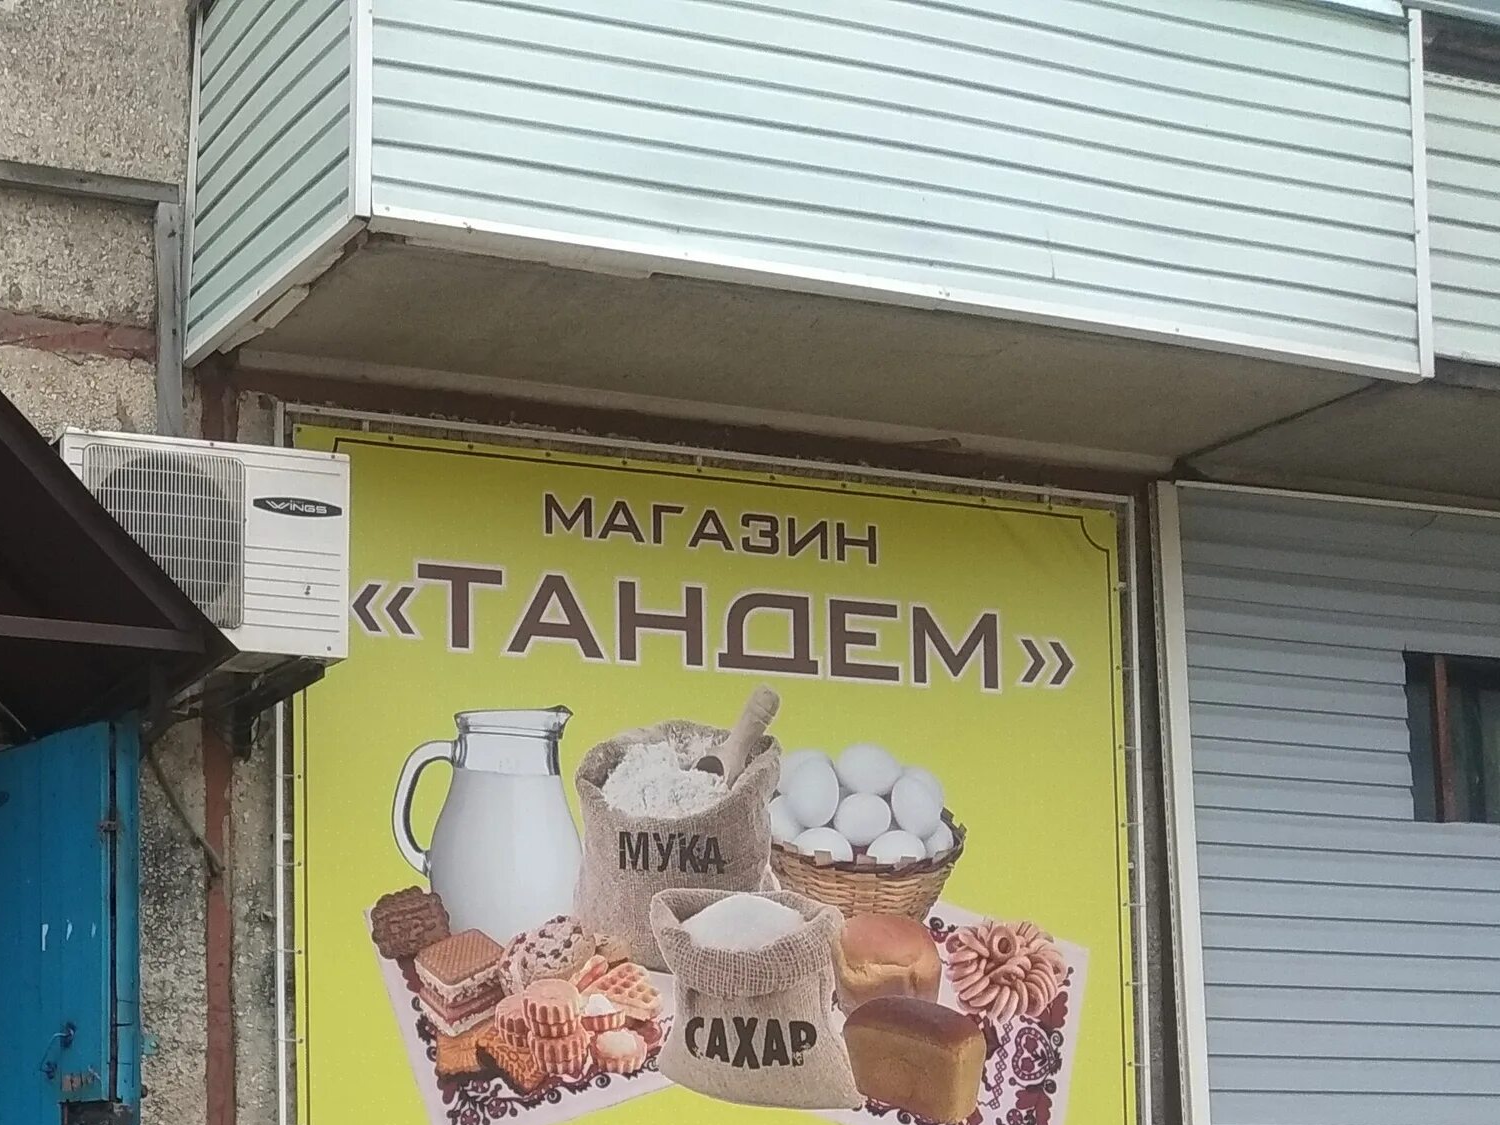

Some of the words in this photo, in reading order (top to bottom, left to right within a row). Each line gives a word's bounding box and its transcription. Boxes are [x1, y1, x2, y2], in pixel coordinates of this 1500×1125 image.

[543, 493, 878, 566] МАГАЗИН
[351, 562, 1076, 691] «ТАНДЕМ»
[618, 831, 727, 874] МУКА
[684, 1016, 818, 1069] САХАР
